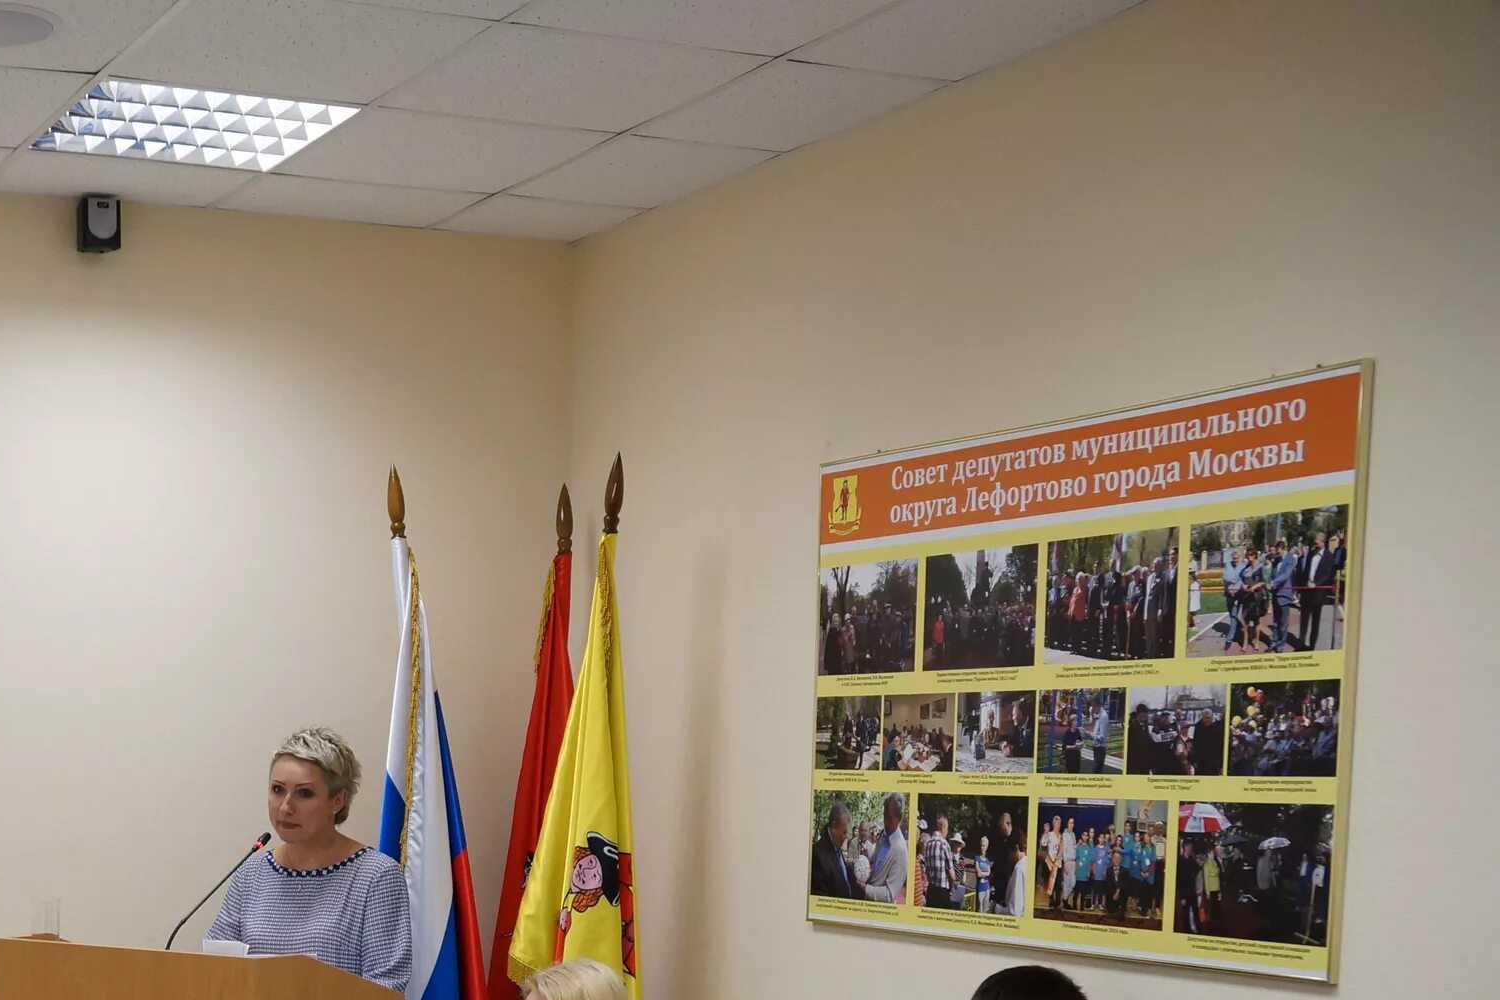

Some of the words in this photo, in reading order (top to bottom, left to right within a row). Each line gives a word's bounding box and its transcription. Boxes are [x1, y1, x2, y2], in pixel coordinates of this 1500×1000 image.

[890, 496, 957, 527] округа
[961, 475, 1088, 516] Лефортово
[1092, 460, 1181, 498] города
[1187, 439, 1305, 480] Москвы
[891, 463, 949, 490] Совет
[952, 443, 1066, 486] депутатов
[1071, 398, 1307, 466] муниципального
